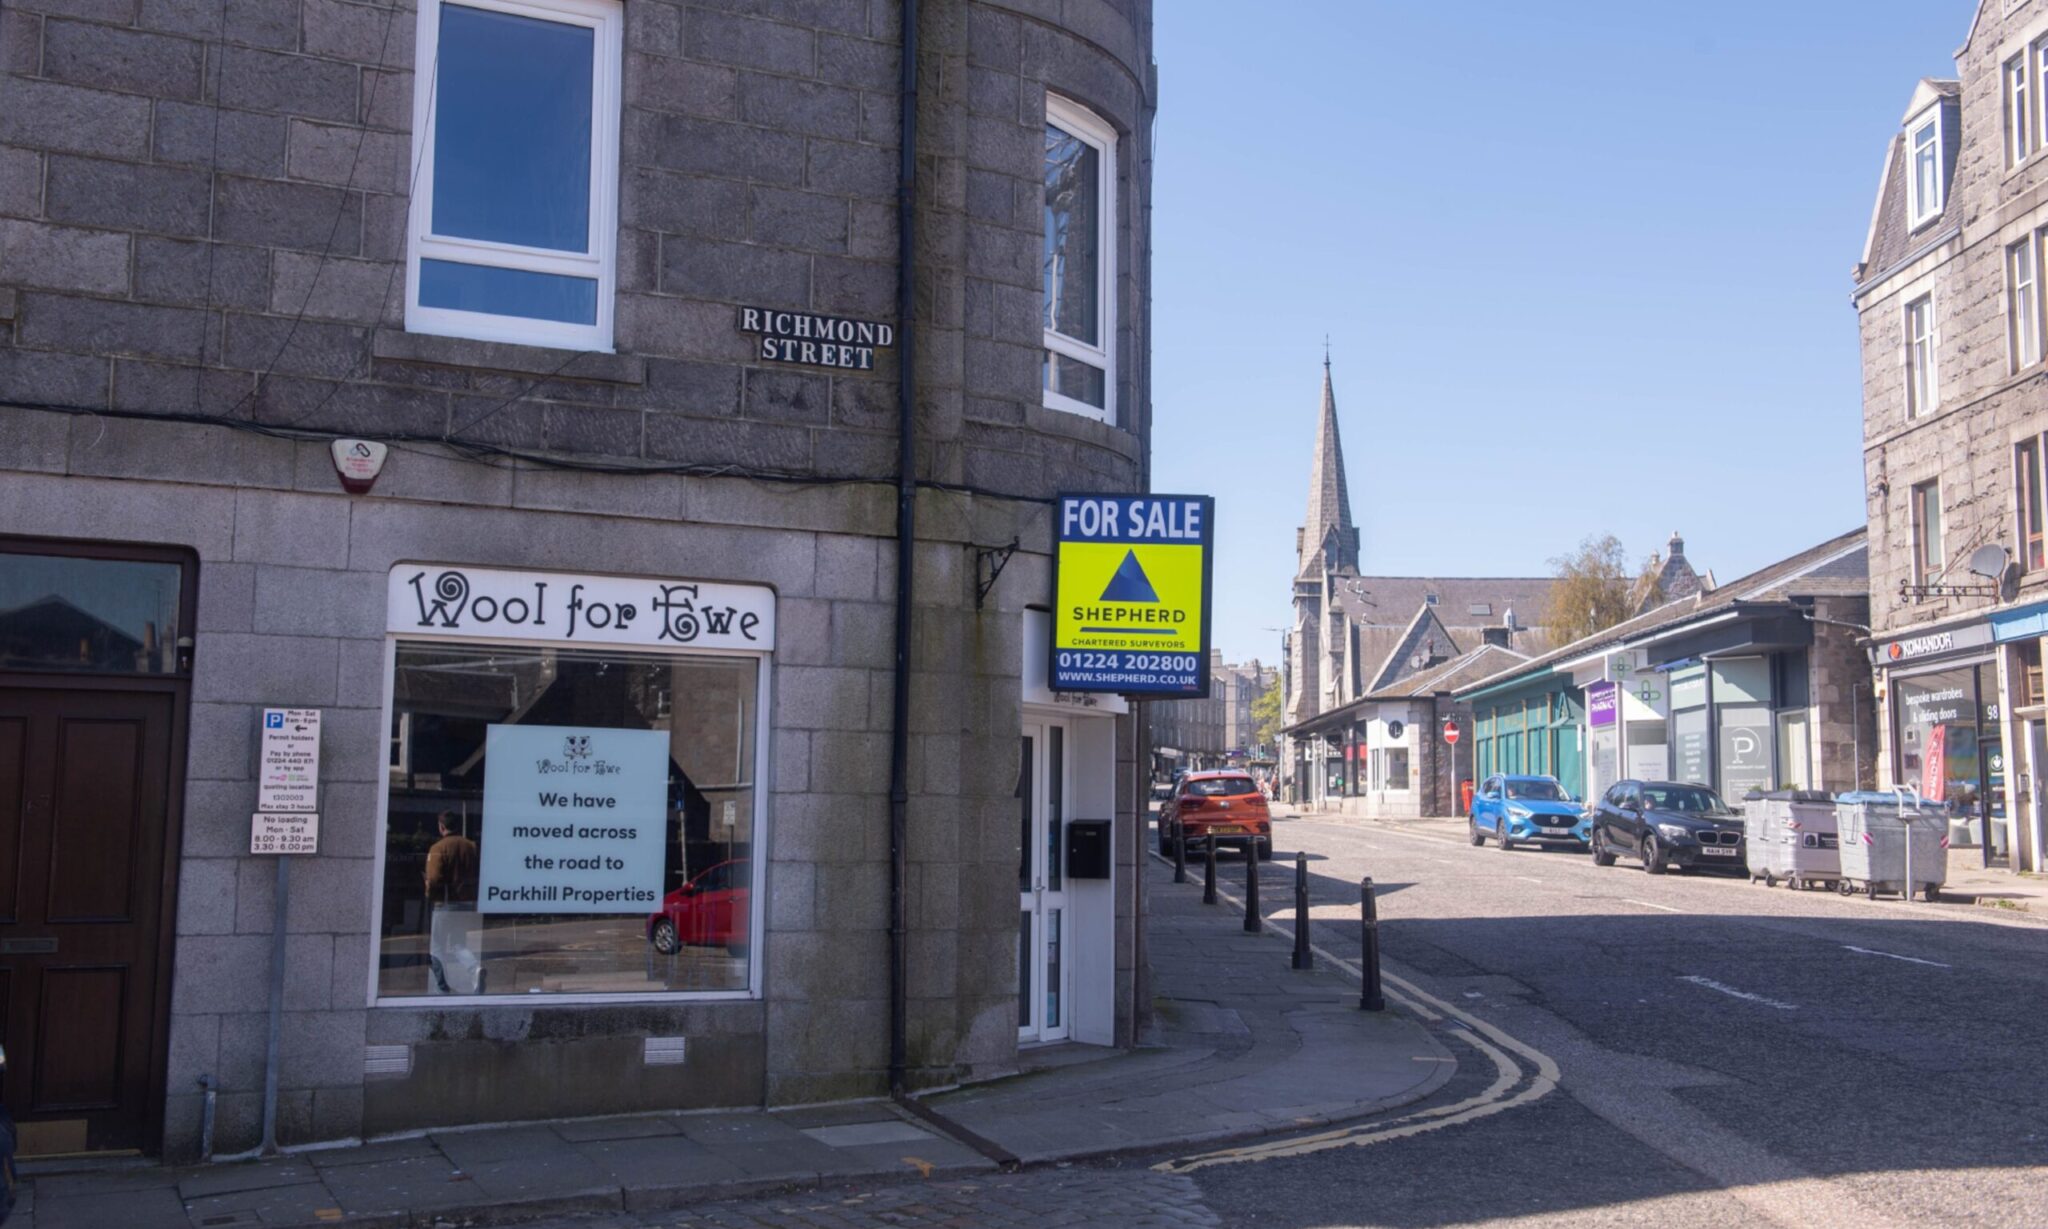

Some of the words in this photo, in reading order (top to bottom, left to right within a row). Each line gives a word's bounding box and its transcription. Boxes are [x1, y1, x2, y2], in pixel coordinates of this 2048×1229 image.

[742, 307, 893, 346] RICHMOND
[762, 337, 873, 369] STREET
[1063, 499, 1120, 537] FOR
[1128, 500, 1201, 539] SALE
[408, 571, 548, 628] Wool
[566, 584, 637, 638] for
[652, 583, 760, 643] Ewe
[1072, 606, 1186, 624] SHEPHERD
[1071, 637, 1127, 648] CHARTERED
[1129, 639, 1186, 649] SURVEYORS
[1902, 632, 1953, 657] KOMANDOR
[1059, 652, 1119, 670] 01224
[1124, 654, 1197, 672] 202800
[1058, 671, 1197, 686] WWW.SHEPHERD.CO.UK
[1931, 688, 1963, 702] wardrobes
[1939, 707, 1957, 720] doors
[1986, 704, 1999, 720] 98
[270, 714, 281, 728] P
[535, 758, 569, 774] Wool
[572, 760, 591, 775] for
[592, 760, 621, 775] Ewe
[538, 792, 569, 807] We
[573, 792, 616, 808] have
[263, 815, 276, 823] No
[278, 816, 308, 824] loading
[512, 824, 574, 838] moved
[578, 826, 637, 839] across
[524, 854, 554, 869] the
[559, 855, 601, 870] road
[605, 856, 624, 870] to
[487, 885, 557, 901] Parkhill
[562, 886, 655, 904] Properties
